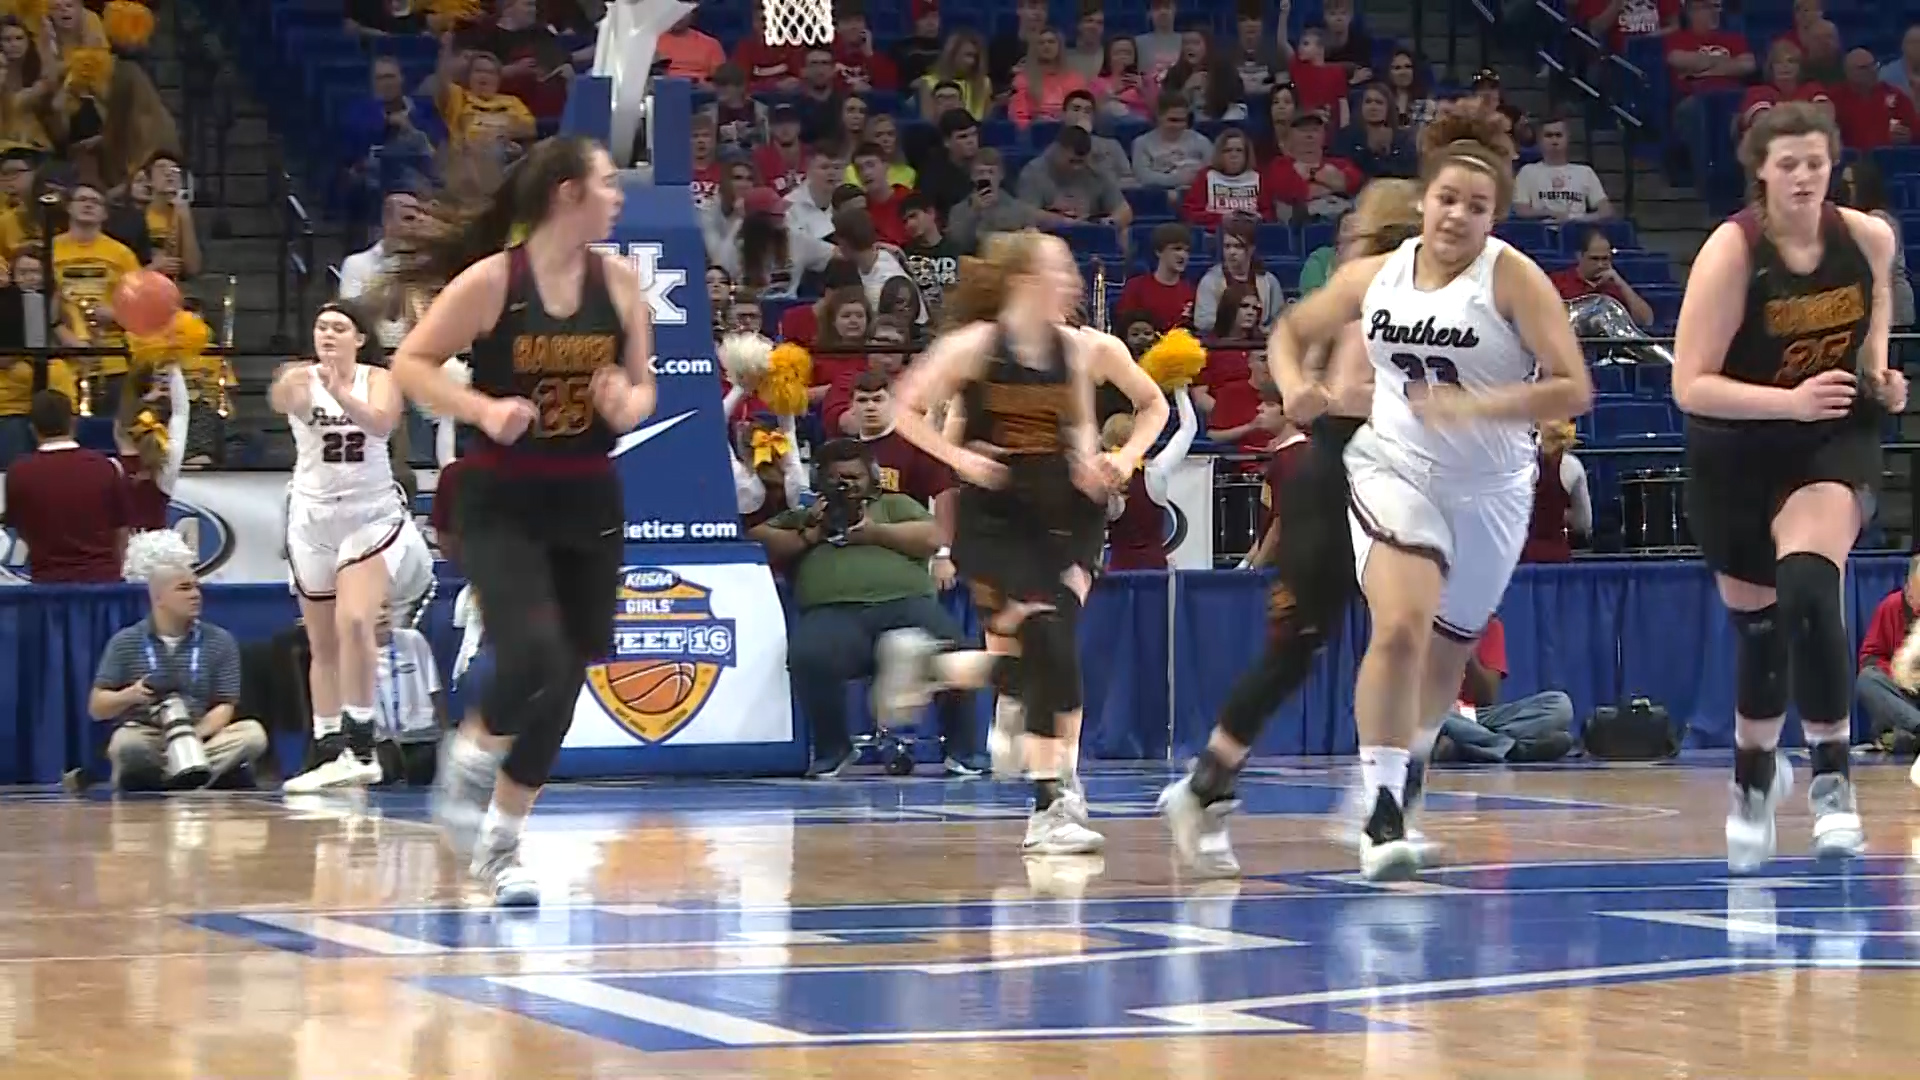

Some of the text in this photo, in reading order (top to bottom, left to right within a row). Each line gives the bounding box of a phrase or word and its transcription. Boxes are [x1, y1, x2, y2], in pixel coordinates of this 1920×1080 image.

[1367, 308, 1480, 349] Panthers
[322, 432, 366, 462] 22
[613, 625, 731, 655] EET 16
